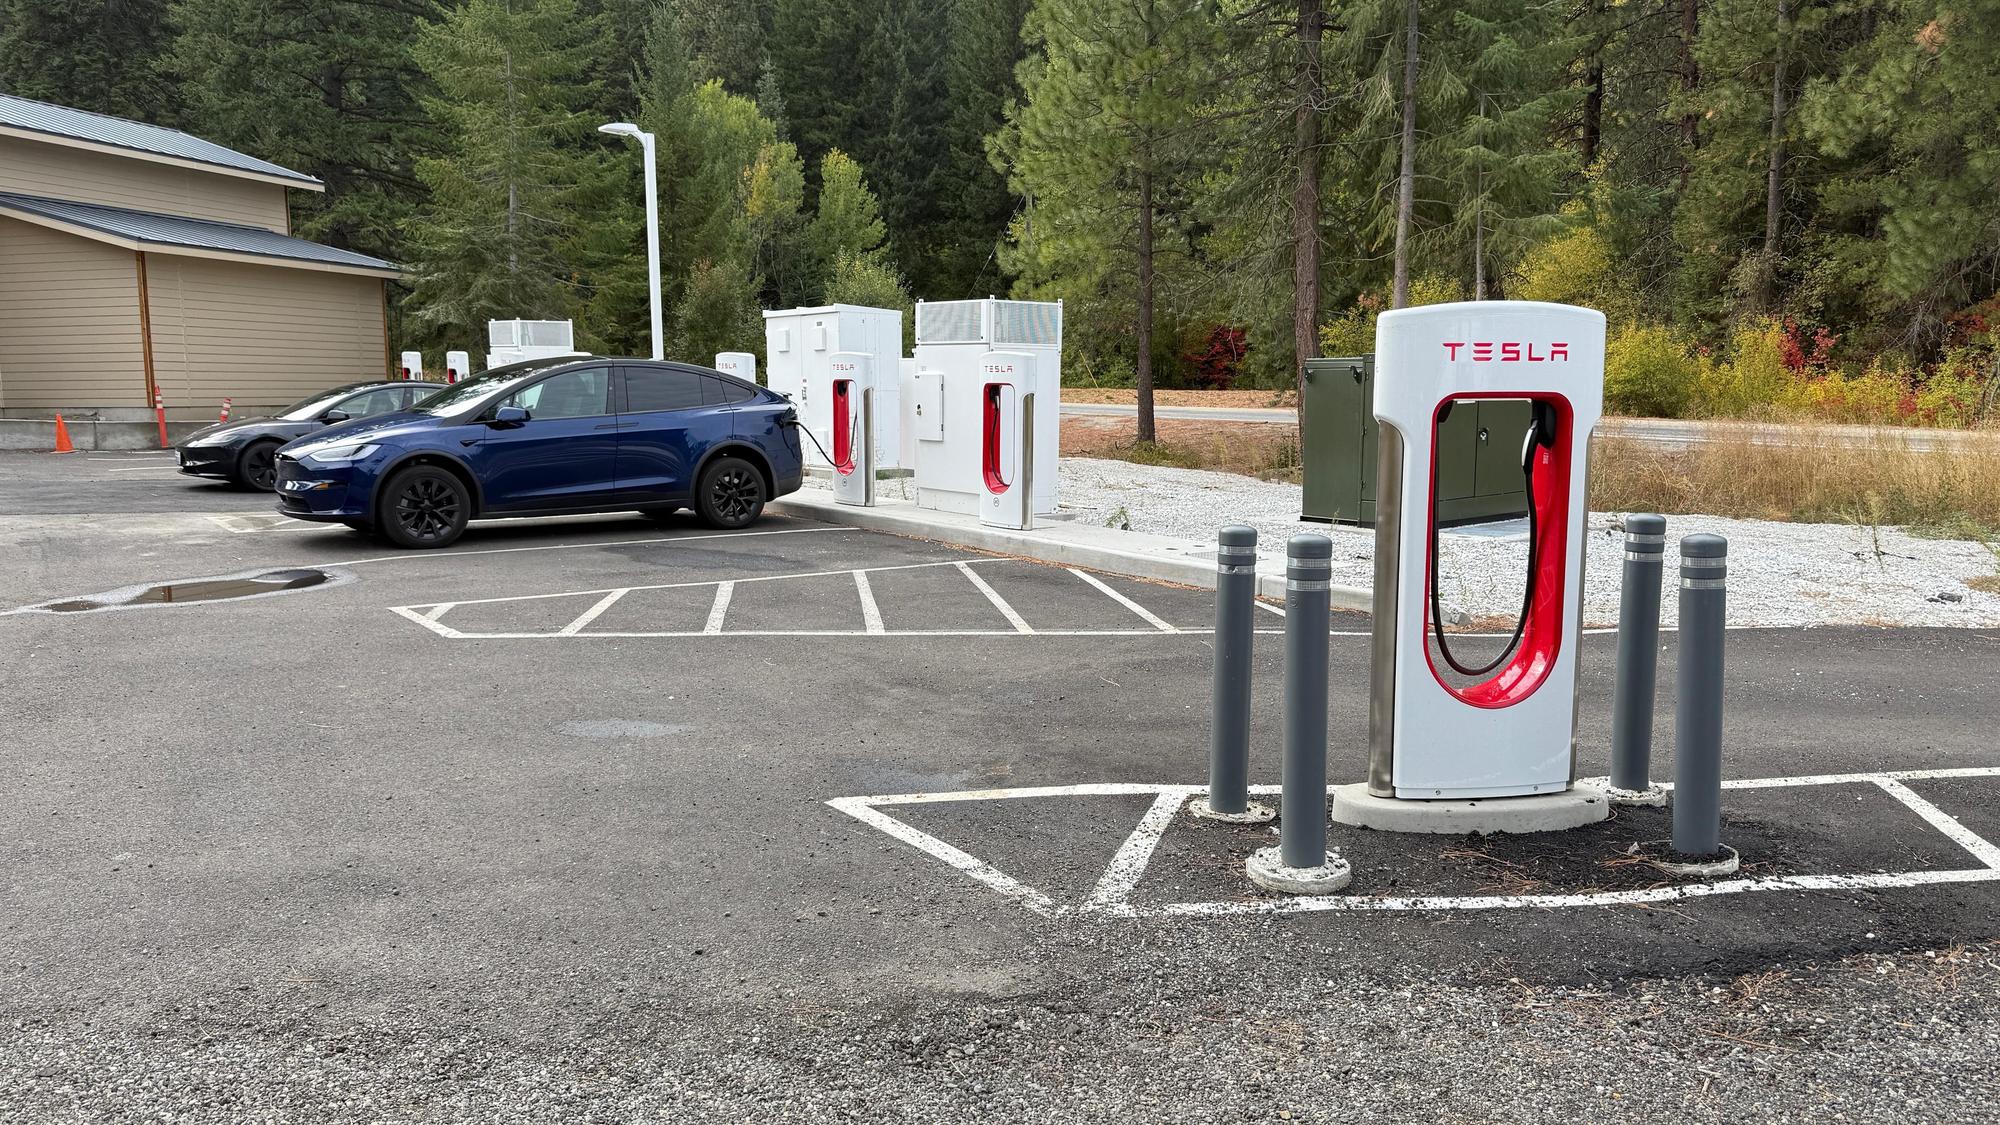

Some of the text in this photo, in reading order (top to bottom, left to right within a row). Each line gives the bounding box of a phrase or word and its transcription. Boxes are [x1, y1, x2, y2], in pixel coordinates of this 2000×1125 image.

[1442, 342, 1568, 361] TESLA
[832, 363, 855, 371] TESLA
[984, 365, 1013, 373] TESLA
